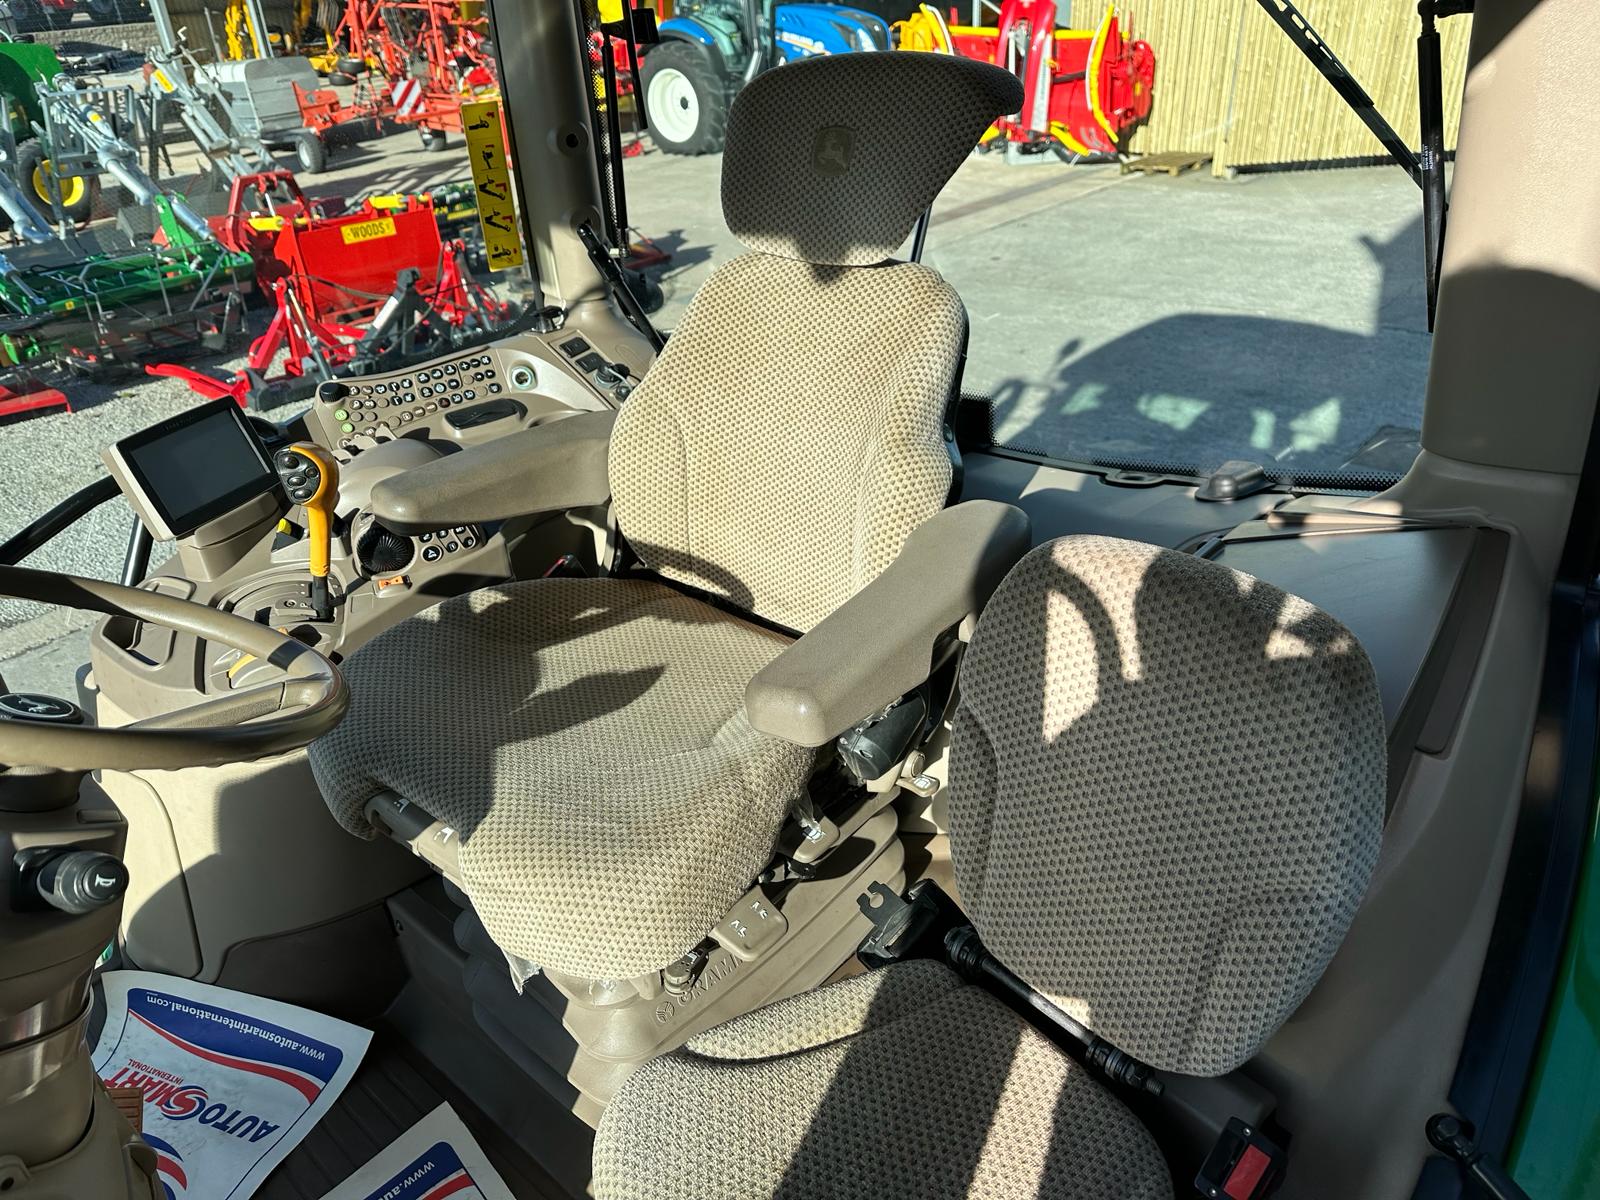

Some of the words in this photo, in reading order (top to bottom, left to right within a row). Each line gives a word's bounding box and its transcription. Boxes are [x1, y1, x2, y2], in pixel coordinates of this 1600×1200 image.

[350, 222, 386, 239] WOODS
[146, 994, 326, 1061] www.autosmartinternational.com
[127, 1058, 185, 1085] INTERNATIONAL
[378, 1161, 436, 1200] www.au
